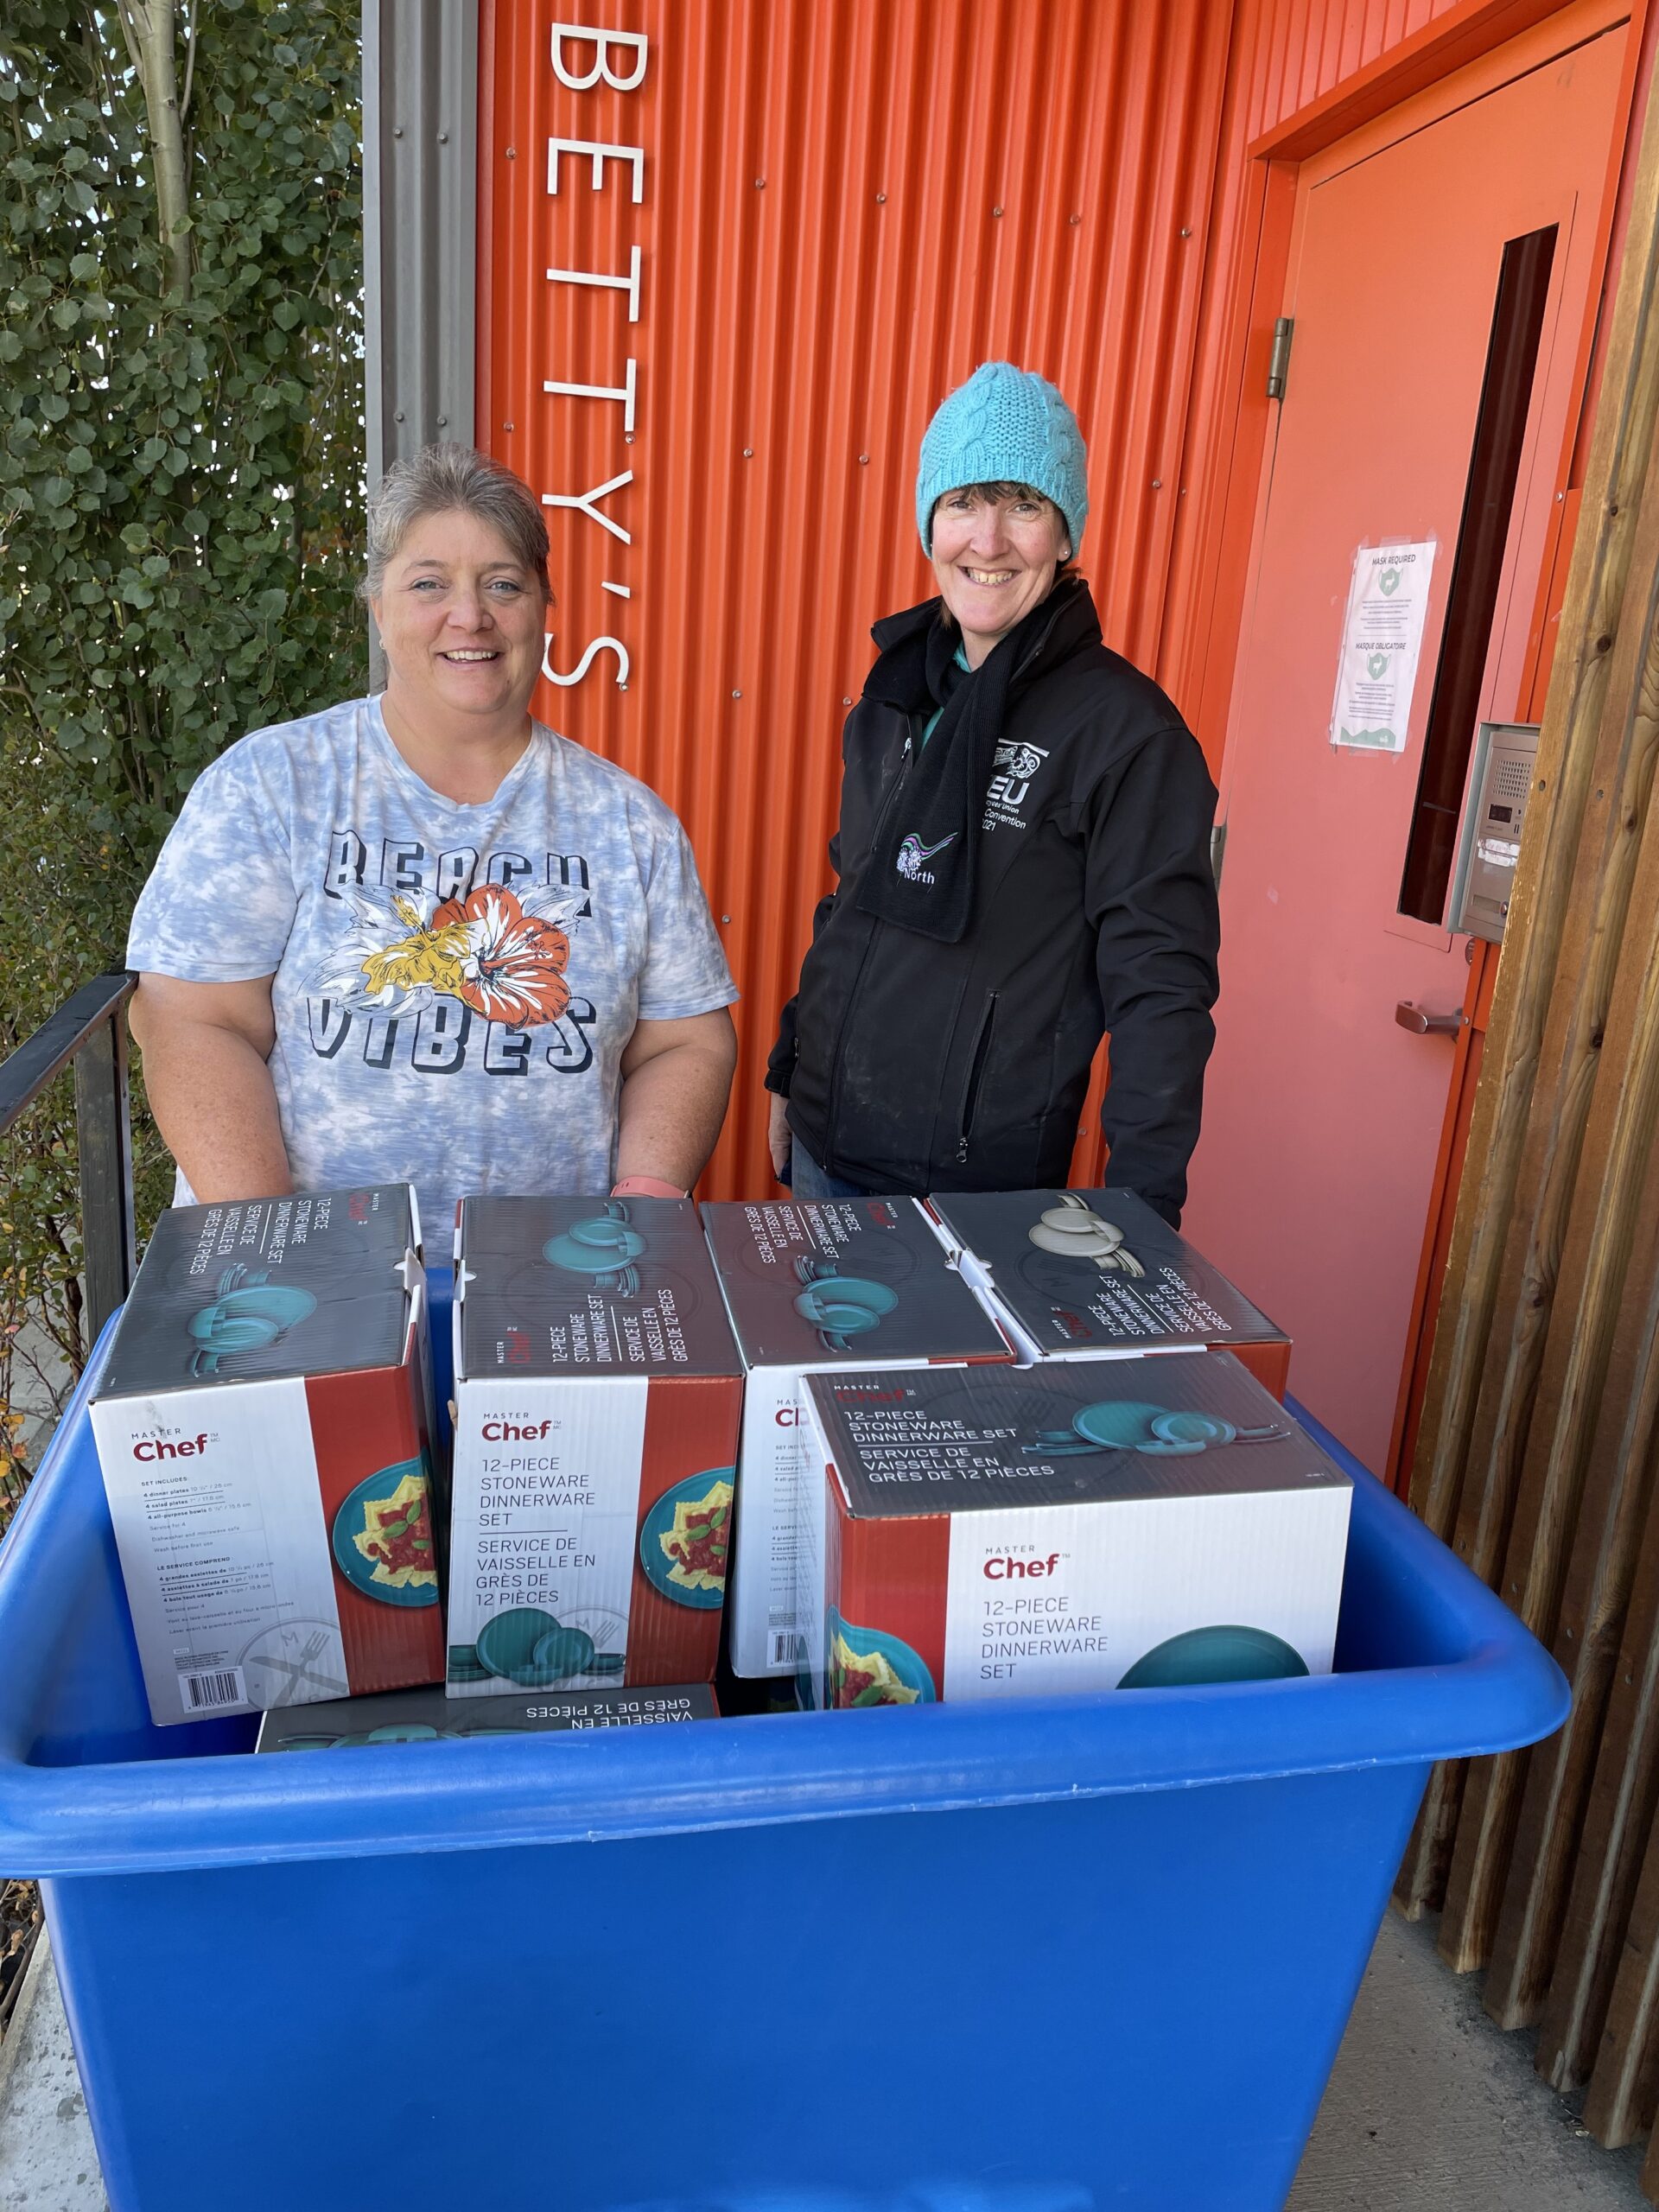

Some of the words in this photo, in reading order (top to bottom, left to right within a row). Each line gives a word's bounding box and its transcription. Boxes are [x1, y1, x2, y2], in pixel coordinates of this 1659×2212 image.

[542, 22, 648, 687] BETTY'S
[1372, 556, 1388, 565] MASK
[1389, 554, 1416, 565] REQUIRED
[1356, 642, 1375, 651] MASQUE
[987, 774, 1030, 804] EU
[1002, 803, 1020, 814] Union
[982, 818, 996, 831] 021
[985, 808, 1027, 829] Convention
[904, 867, 935, 884] North
[307, 993, 596, 1077] VIBES
[314, 1198, 331, 1230] 12-PIECE
[745, 1207, 761, 1223] GRÈS
[779, 1205, 799, 1230] SERVICE
[839, 1204, 861, 1231] 12-PIECE
[885, 1202, 898, 1218] MASTER
[204, 1209, 222, 1228] GRÈS
[219, 1206, 242, 1244] VAISSELLE
[242, 1205, 262, 1234] SERVICE
[270, 1202, 292, 1249] DINNERWARE
[291, 1200, 311, 1244] STONEWARE
[762, 1206, 785, 1237] VAISSELLE
[822, 1205, 849, 1243] STONEWARE
[201, 1229, 217, 1238] DE
[750, 1224, 765, 1232] DE
[804, 1205, 833, 1245] DINNERWARE
[823, 1246, 839, 1258] SET
[198, 1239, 214, 1248] 12
[239, 1236, 255, 1245] DE
[773, 1239, 788, 1248] EN
[217, 1245, 232, 1255] EN
[267, 1250, 282, 1263] SET
[757, 1242, 776, 1263] PIÈCES
[189, 1249, 211, 1274] PIÈCES
[1099, 1275, 1121, 1288] SET
[1160, 1268, 1191, 1291] PIÈCES
[1145, 1293, 1164, 1302] DE
[1156, 1285, 1175, 1294] EN
[588, 1294, 603, 1309] SET
[658, 1289, 677, 1315] PIÈCES
[1192, 1300, 1211, 1310] DE
[642, 1308, 657, 1318] EN
[1096, 1293, 1146, 1335] STONEWARE
[1112, 1289, 1165, 1334] DINNERWARE
[1155, 1303, 1194, 1332] SERVICE
[1166, 1295, 1212, 1332] VAISSELLE
[623, 1317, 638, 1326] DE
[664, 1317, 679, 1325] 12
[1088, 1306, 1125, 1336] 12-PIECE
[1203, 1311, 1232, 1331] GRÈS
[569, 1313, 590, 1362] STONEWARE
[590, 1311, 612, 1362] DINNERWARE
[644, 1319, 666, 1362] VAISSELLE
[666, 1327, 683, 1338] DE
[550, 1326, 568, 1362] 12-PIECE
[625, 1328, 645, 1362] SERVICE
[668, 1339, 688, 1361] GRÈS
[844, 1410, 927, 1421] 12-PIECE
[131, 1427, 181, 1440] MASTER
[481, 1421, 552, 1441] Chef
[849, 1421, 965, 1432] STONEWARE
[853, 1430, 979, 1444] DINNERWARE
[983, 1428, 1018, 1440] SET
[133, 1433, 207, 1462] Chef
[860, 1448, 941, 1459] SERVICE
[946, 1447, 971, 1457] DE
[482, 1457, 560, 1472] 12-PIECE
[863, 1459, 969, 1471] VAISSELLE
[973, 1457, 1000, 1467] EN
[868, 1470, 923, 1483] GRÈS
[929, 1470, 954, 1481] DE
[957, 1470, 981, 1479] 12
[986, 1465, 1055, 1478] PIÈCES
[480, 1475, 589, 1490] STONEWARE
[480, 1492, 595, 1508] DINNERWARE
[479, 1513, 512, 1527] SET
[478, 1538, 550, 1554] SERVICE
[556, 1537, 577, 1550] DE
[985, 1545, 1035, 1554] MASTER
[167, 1561, 194, 1570] SERVICE
[194, 1556, 231, 1567] COMPREND
[477, 1555, 569, 1571] VAISSELLE
[574, 1554, 595, 1567] EN
[983, 1553, 1060, 1580] Chef
[476, 1573, 522, 1589] GRÈS
[528, 1573, 549, 1586] DE
[476, 1593, 493, 1606] 12
[499, 1590, 559, 1605] PIÈCES
[983, 1597, 1069, 1617] 12-PIECE
[982, 1616, 1102, 1637] STONEWARE
[982, 1637, 1109, 1659] DINNERWARE
[980, 1663, 1017, 1680] SET
[526, 1706, 588, 1719] PIÈCES
[594, 1704, 612, 1715] 12
[618, 1702, 639, 1713] DE
[644, 1699, 690, 1711] GRÈS
[571, 1718, 594, 1730] EN
[601, 1711, 693, 1727] VAISSELLE
